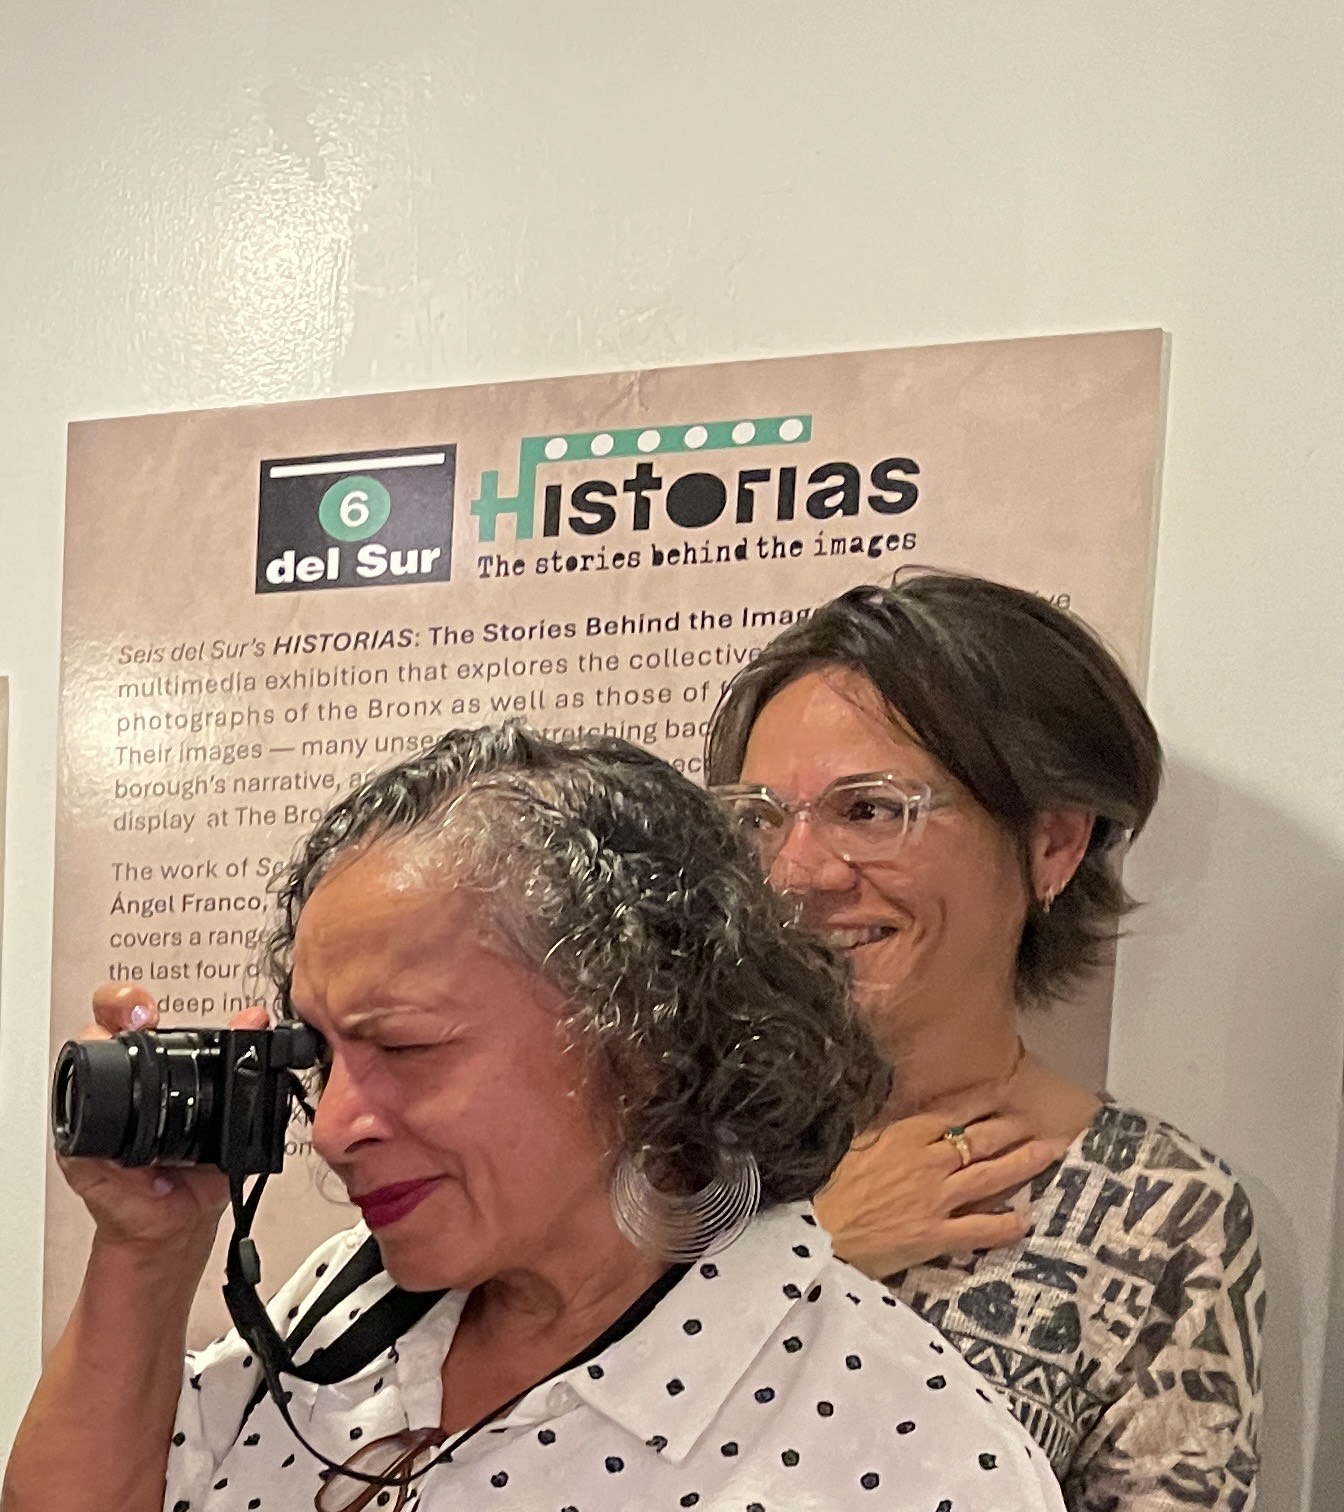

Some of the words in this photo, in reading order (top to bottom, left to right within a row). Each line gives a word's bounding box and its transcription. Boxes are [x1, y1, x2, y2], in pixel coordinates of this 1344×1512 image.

[470, 415, 921, 543] Historias
[338, 490, 370, 528] 6
[265, 548, 339, 586] del
[355, 541, 440, 579] Sur
[477, 554, 526, 579] The
[535, 543, 641, 575] stories
[651, 537, 748, 568] behind
[757, 534, 804, 560] the
[812, 529, 917, 561] images
[118, 644, 164, 666] Seis
[171, 641, 204, 662] del
[273, 628, 421, 656] HISTORIAS:
[429, 623, 474, 646] The
[483, 618, 576, 643] Stories
[586, 611, 680, 637] Behind
[689, 609, 732, 630] the
[118, 672, 256, 698] multimedia
[265, 666, 389, 691] exhibition
[398, 663, 448, 683] that
[457, 653, 567, 683] explores
[578, 652, 619, 673] the
[117, 705, 274, 736] photographs
[284, 702, 309, 724] of
[317, 701, 358, 721] the
[368, 697, 442, 719] Bronx
[451, 698, 481, 714] as
[491, 689, 545, 712] well
[555, 692, 584, 709] as
[596, 687, 671, 707] those
[683, 680, 710, 702] of
[115, 744, 172, 766] Their
[179, 737, 262, 764] images
[302, 734, 368, 759] many
[665, 718, 711, 739] bac
[114, 775, 226, 801] borough's
[233, 771, 341, 792] narrative,
[113, 808, 195, 834] display
[207, 806, 228, 827] at
[235, 805, 276, 826] The
[284, 801, 324, 825] Bro
[112, 862, 153, 882] The
[160, 859, 218, 880] work
[226, 858, 248, 878] of
[110, 891, 174, 918] Ángel
[182, 893, 268, 913] Franco,
[110, 930, 182, 948] covers
[189, 932, 201, 945] a
[208, 927, 261, 948] rang
[109, 962, 143, 981] the
[150, 958, 190, 980] last
[197, 959, 241, 979] four
[158, 994, 215, 1016] deep
